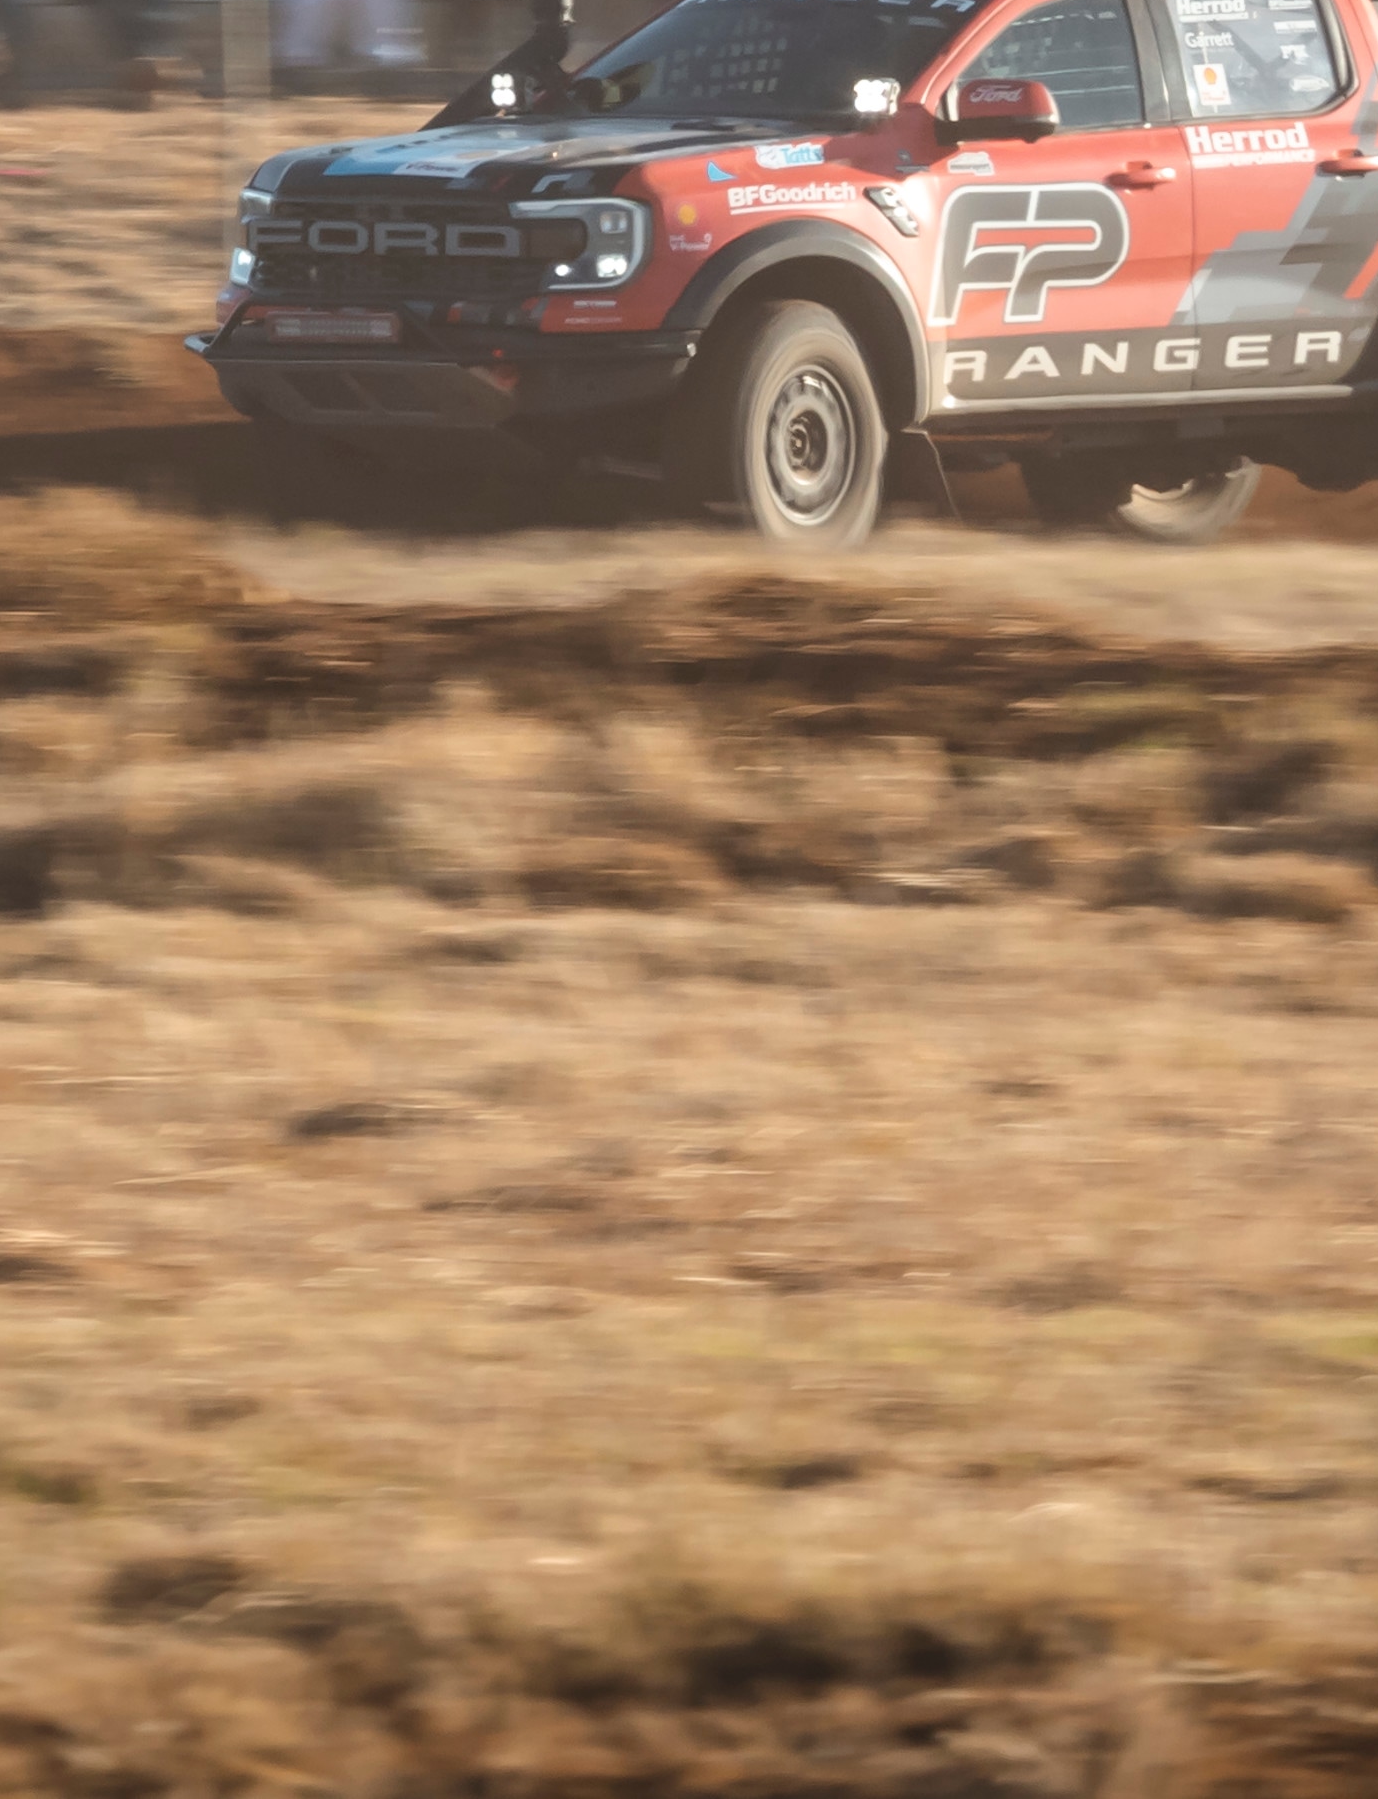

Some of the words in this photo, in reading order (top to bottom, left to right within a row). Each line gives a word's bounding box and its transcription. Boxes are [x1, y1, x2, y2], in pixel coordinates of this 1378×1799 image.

[1185, 32, 1234, 48] Garrett
[970, 86, 1024, 102] Ford
[1185, 122, 1309, 153] Herrod
[728, 182, 856, 207] BFGoodrich
[248, 220, 521, 257] FORD
[943, 331, 1343, 384] RANGER
